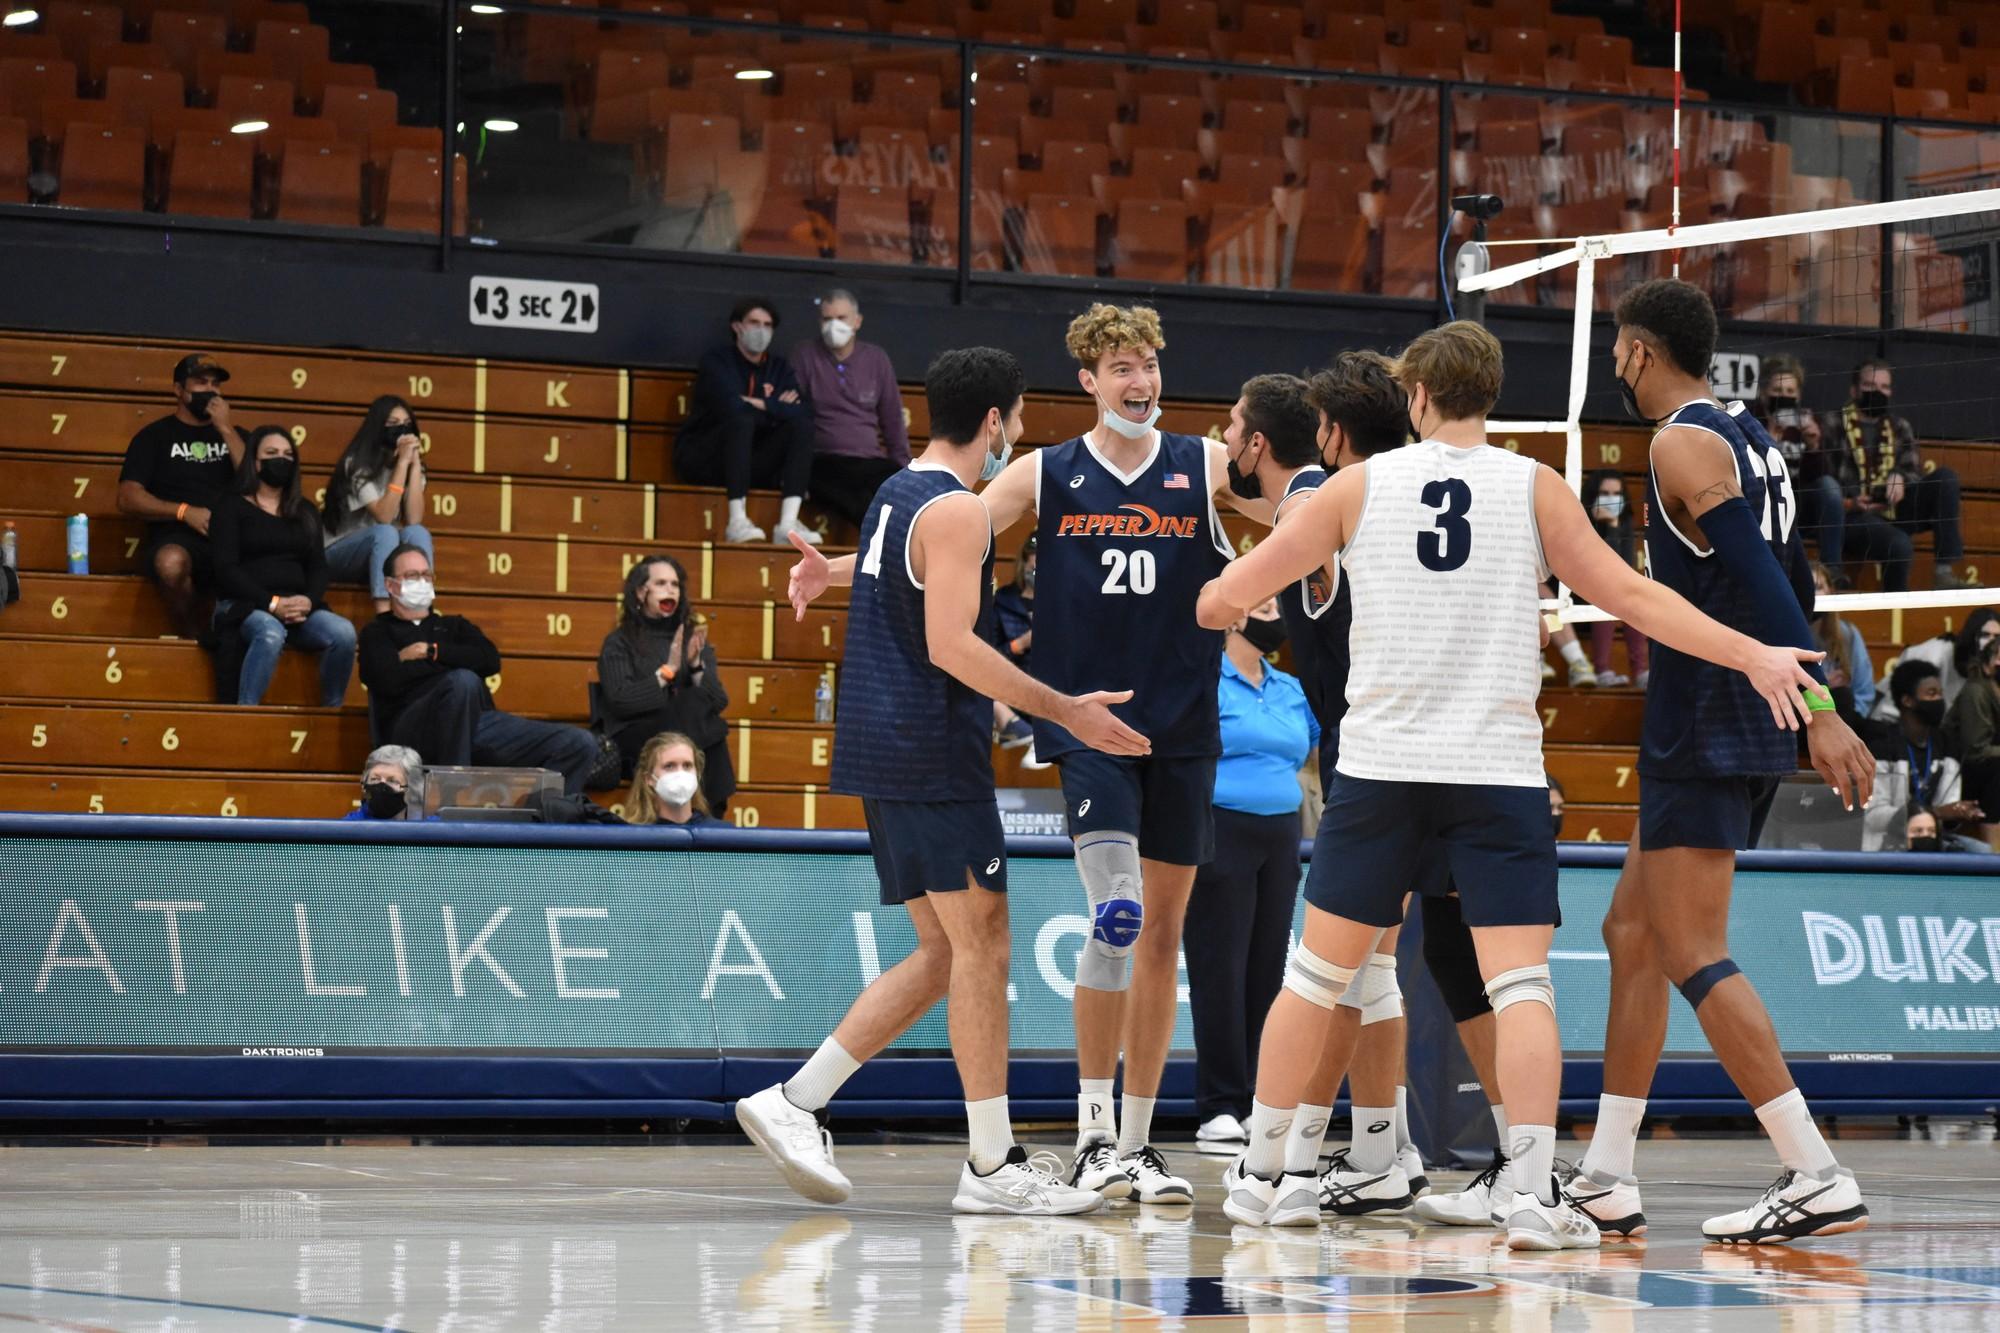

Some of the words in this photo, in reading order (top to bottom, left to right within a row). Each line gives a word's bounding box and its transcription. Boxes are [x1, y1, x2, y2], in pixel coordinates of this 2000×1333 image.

[492, 286, 509, 320] 3
[519, 294, 552, 318] SEC
[560, 289, 577, 325] 2
[52, 356, 66, 375] 7
[292, 368, 307, 388] 9
[409, 376, 432, 397] 10
[547, 381, 569, 407] K
[678, 396, 685, 414] 1
[52, 414, 66, 434] 7
[291, 425, 306, 446] 9
[419, 433, 431, 453] 0
[544, 437, 559, 462] J
[1600, 445, 1620, 464] 10
[74, 478, 89, 497] 7
[433, 495, 456, 515] 10
[704, 510, 712, 529] 1
[1056, 504, 1199, 538] PEPPERDINE
[1416, 477, 1473, 572] 3
[126, 538, 139, 557] 7
[488, 553, 512, 575] 10
[1101, 549, 1156, 595] 20
[760, 567, 768, 587] 1
[1966, 566, 1978, 584] 2
[52, 597, 67, 618] 6
[547, 614, 571, 636] 10
[822, 626, 830, 646] 1
[106, 662, 122, 683] 6
[487, 674, 501, 693] 9
[748, 676, 763, 704] F
[1544, 709, 1557, 727] 7
[32, 725, 46, 747] 5
[162, 728, 179, 750] 6
[291, 731, 307, 752] 7
[812, 738, 828, 765] E
[1616, 767, 1630, 787] 7
[89, 795, 103, 813] 5
[221, 797, 238, 816] 6
[734, 807, 759, 827] 10
[998, 810, 1064, 825] INSTANT
[1586, 828, 1602, 842] 6
[294, 901, 621, 998] LIKE
[701, 910, 785, 1000] A
[242, 1048, 324, 1056] DAKTRONICS
[1829, 1053, 1893, 1062] DAKTRONICS
